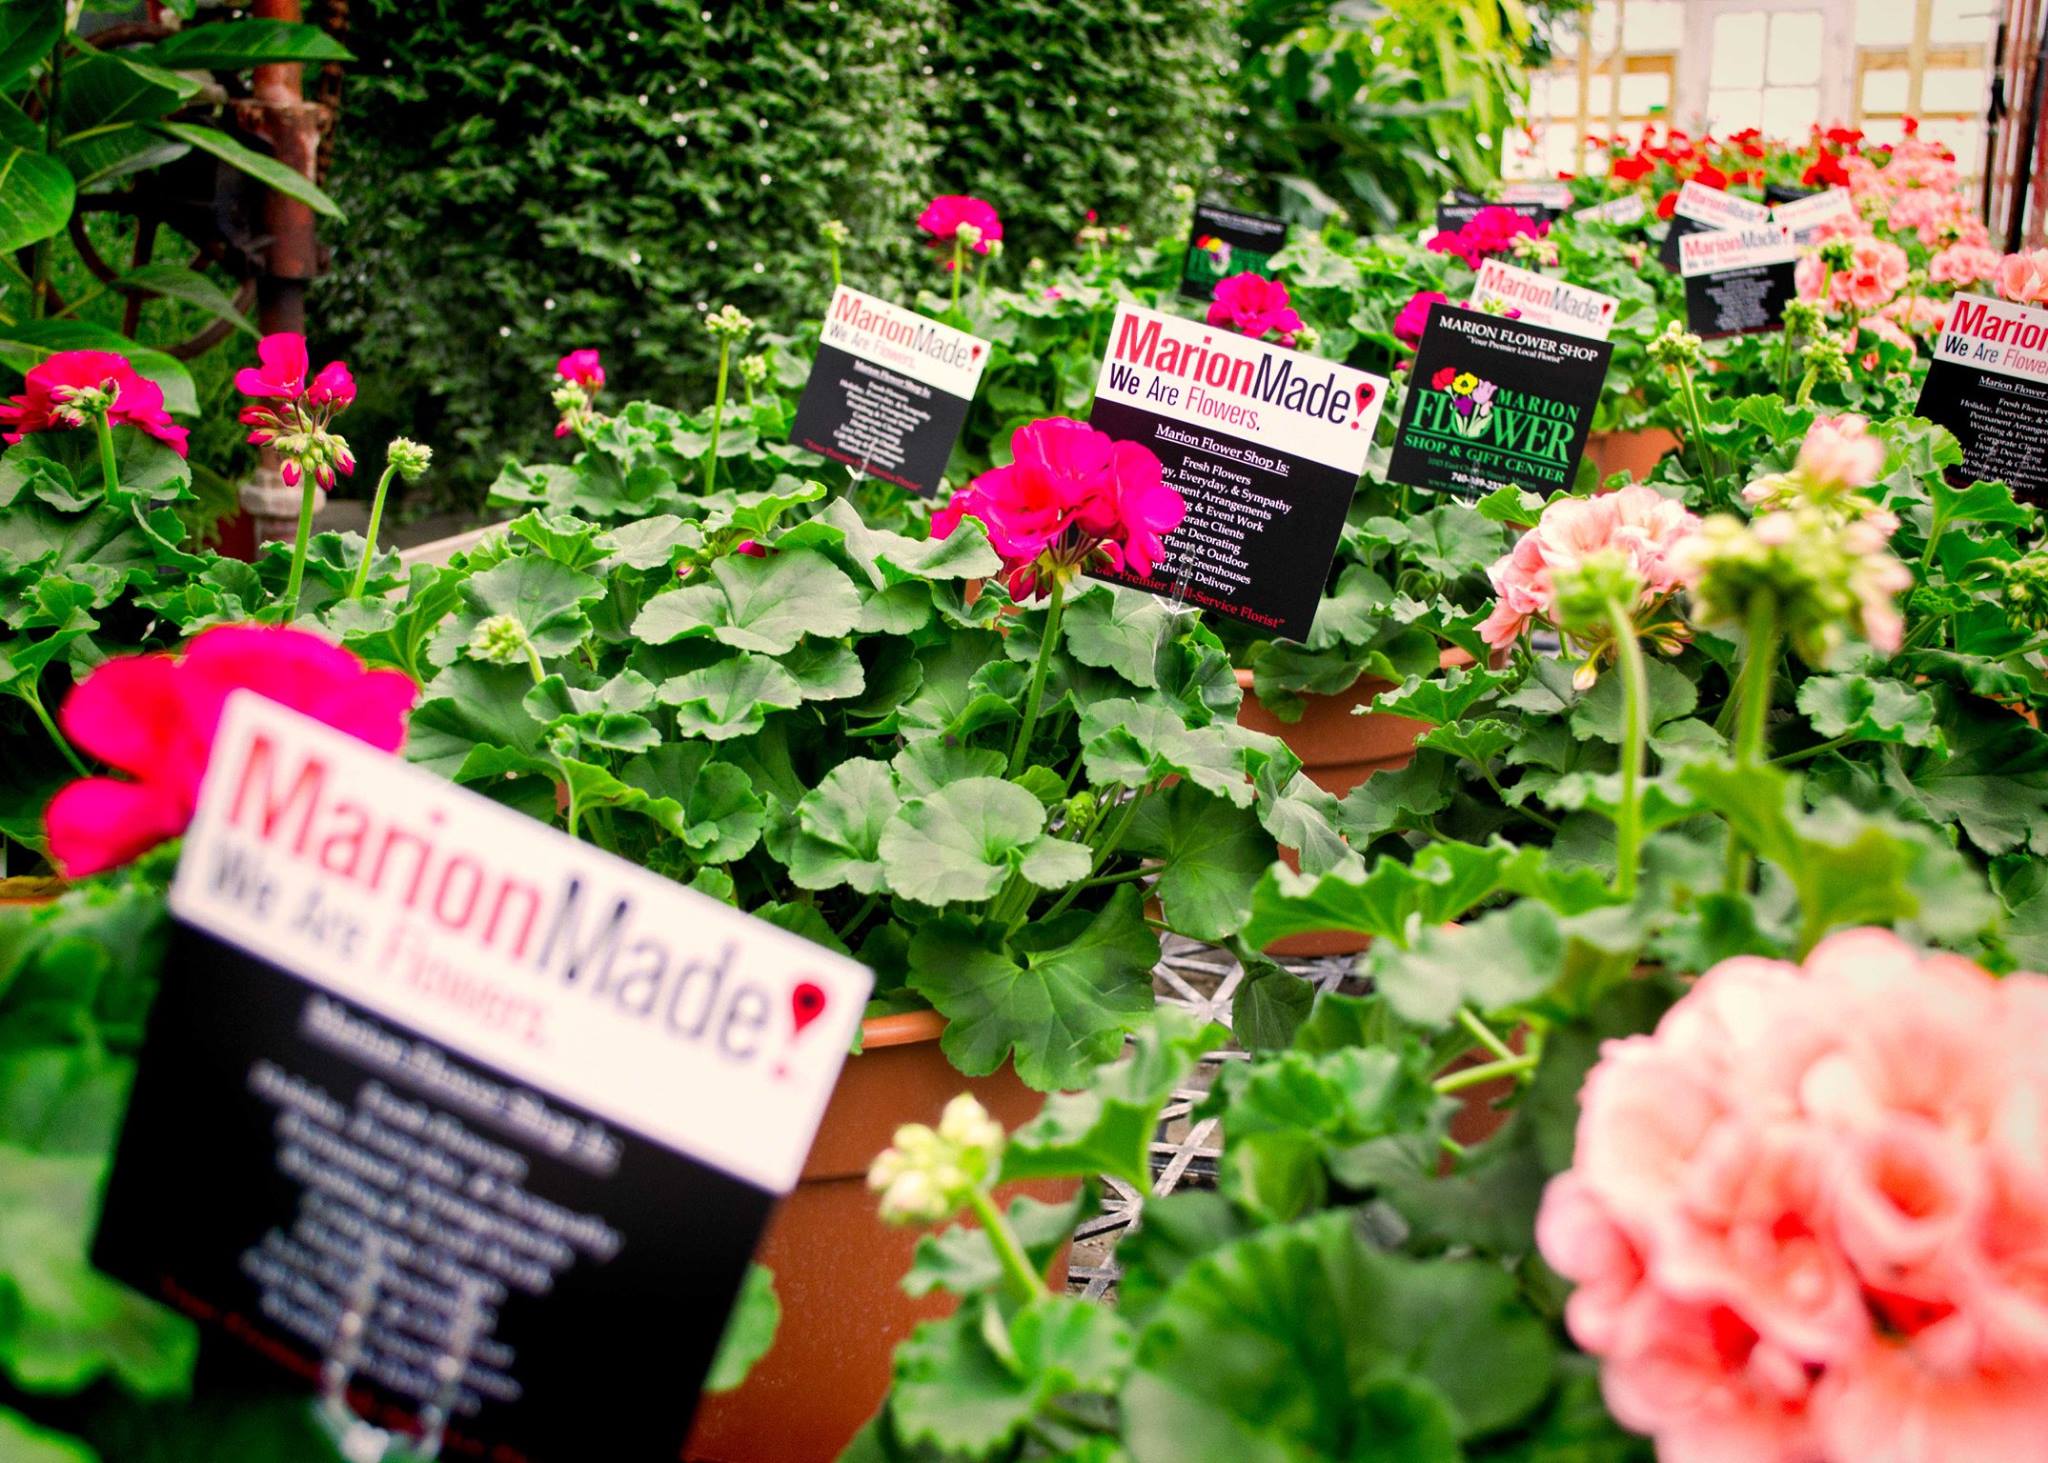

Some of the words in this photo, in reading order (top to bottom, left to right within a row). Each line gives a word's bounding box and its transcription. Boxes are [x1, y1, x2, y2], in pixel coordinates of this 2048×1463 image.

[1439, 315, 1499, 340] MARION
[1500, 329, 1557, 353] FLOWER
[1558, 343, 1599, 362] SHOP
[1944, 335, 1968, 356] We
[1973, 343, 1999, 363] Are
[1114, 313, 1376, 430] MarionMade!
[1979, 375, 2013, 391] Marion
[1109, 362, 1140, 396] We
[1146, 375, 1179, 406] Are
[1185, 386, 1261, 431] Flowers.
[1496, 388, 1581, 422] MARION
[1408, 388, 1575, 464] FLOWER
[1155, 423, 1199, 447] Marion
[1201, 436, 1243, 459] Flower
[1243, 449, 1274, 470] Shop
[1276, 459, 1290, 474] Is:
[1403, 434, 1447, 454] SHOP
[1450, 445, 1461, 458] &
[1466, 448, 1503, 467] GIFT
[1504, 458, 1566, 483] CENTER
[1182, 455, 1210, 473] Fresh
[1211, 464, 1251, 486] Flowers
[1160, 480, 1201, 498] manent
[1202, 491, 1272, 520] Arrangements
[1179, 469, 1230, 494] Everyday,
[1230, 485, 1240, 496] &
[1241, 488, 1292, 515] Sympathy
[1183, 515, 1209, 529] orate
[1210, 521, 1245, 540] Clients
[1194, 502, 1204, 513] &
[1206, 505, 1235, 523] Event
[1237, 515, 1264, 533] Work
[1188, 527, 1241, 556] Decorating
[1196, 544, 1205, 556] &
[1206, 548, 1249, 570] Outdoor
[1151, 561, 1194, 579] orldwide
[1194, 571, 1237, 595] Delivery
[1191, 556, 1251, 585] Greenhouses
[226, 734, 827, 1079] MarionMade!
